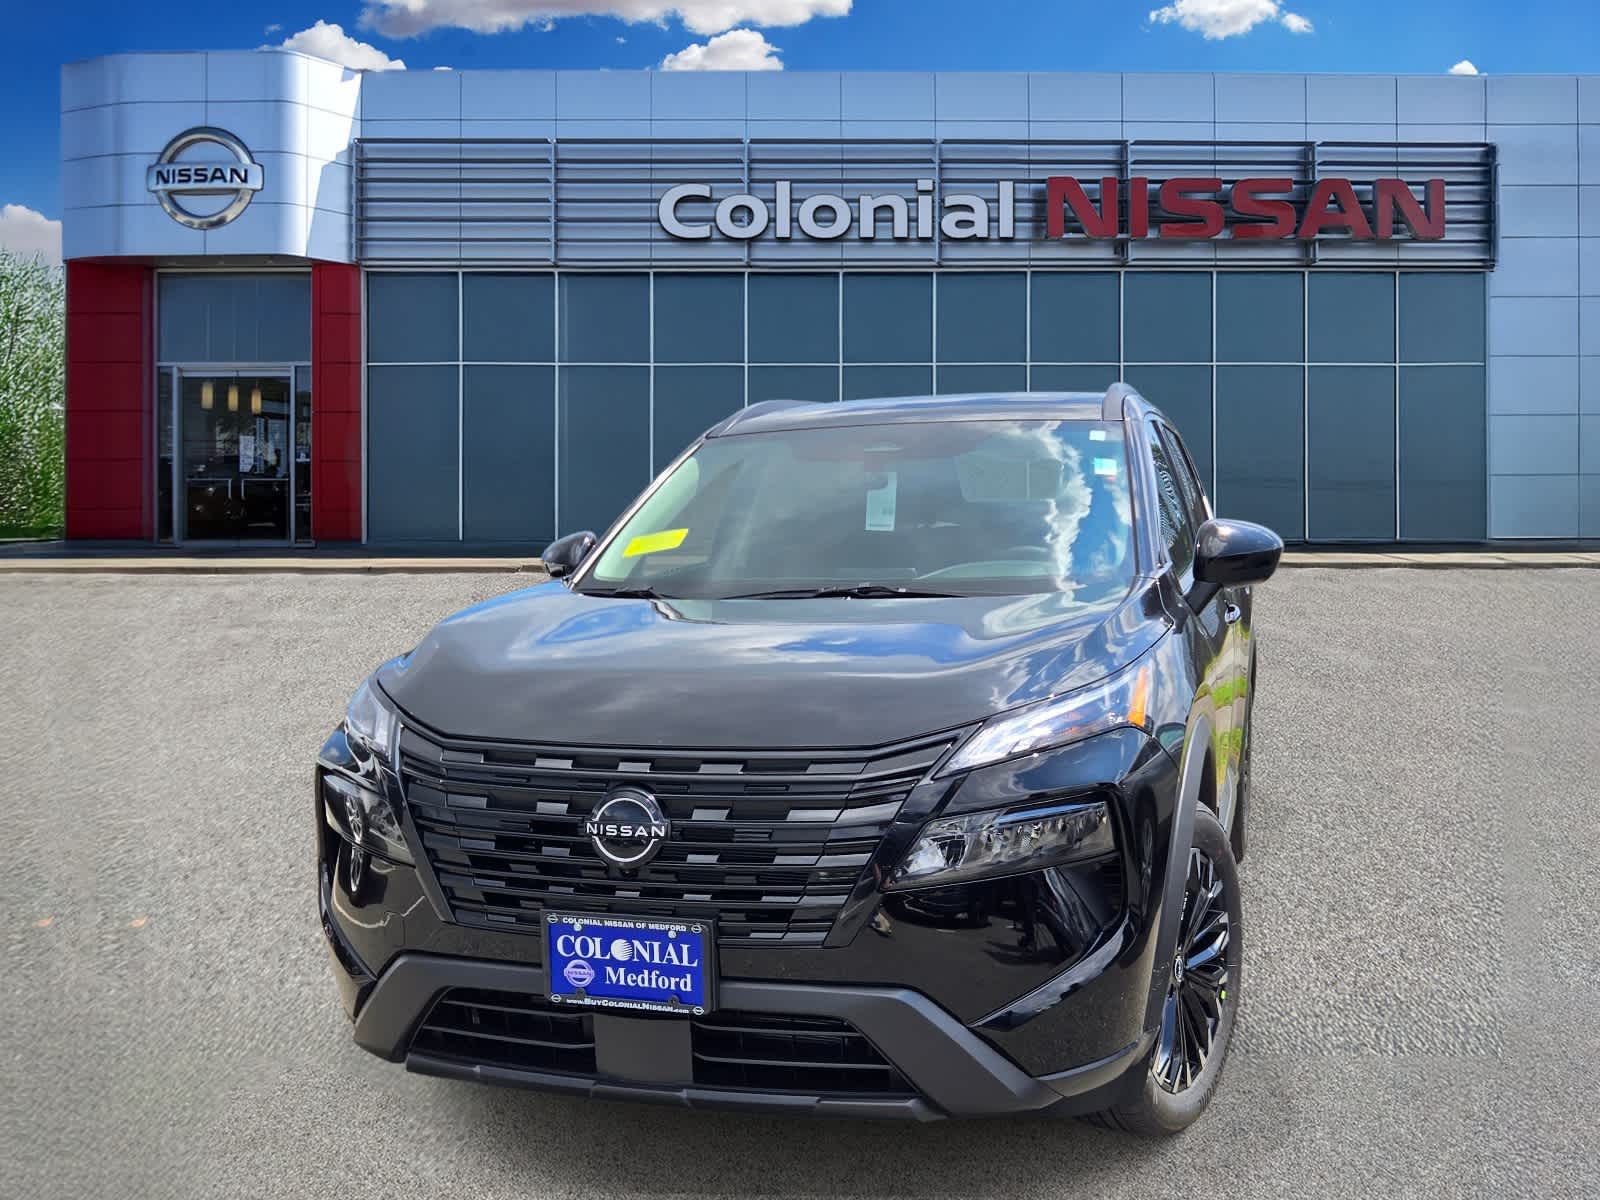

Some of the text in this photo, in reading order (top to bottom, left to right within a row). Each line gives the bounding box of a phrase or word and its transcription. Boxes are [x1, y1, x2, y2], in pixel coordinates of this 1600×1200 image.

[156, 167, 248, 185] NISSAN
[658, 176, 1446, 240] Colonial NISSAN
[586, 822, 665, 837] NISSAN
[562, 917, 603, 927] COLONIAL
[604, 920, 635, 929] NISSAN
[648, 923, 687, 932] MEDFORD
[556, 934, 699, 967] COLONIAL
[605, 966, 693, 992] Medford
